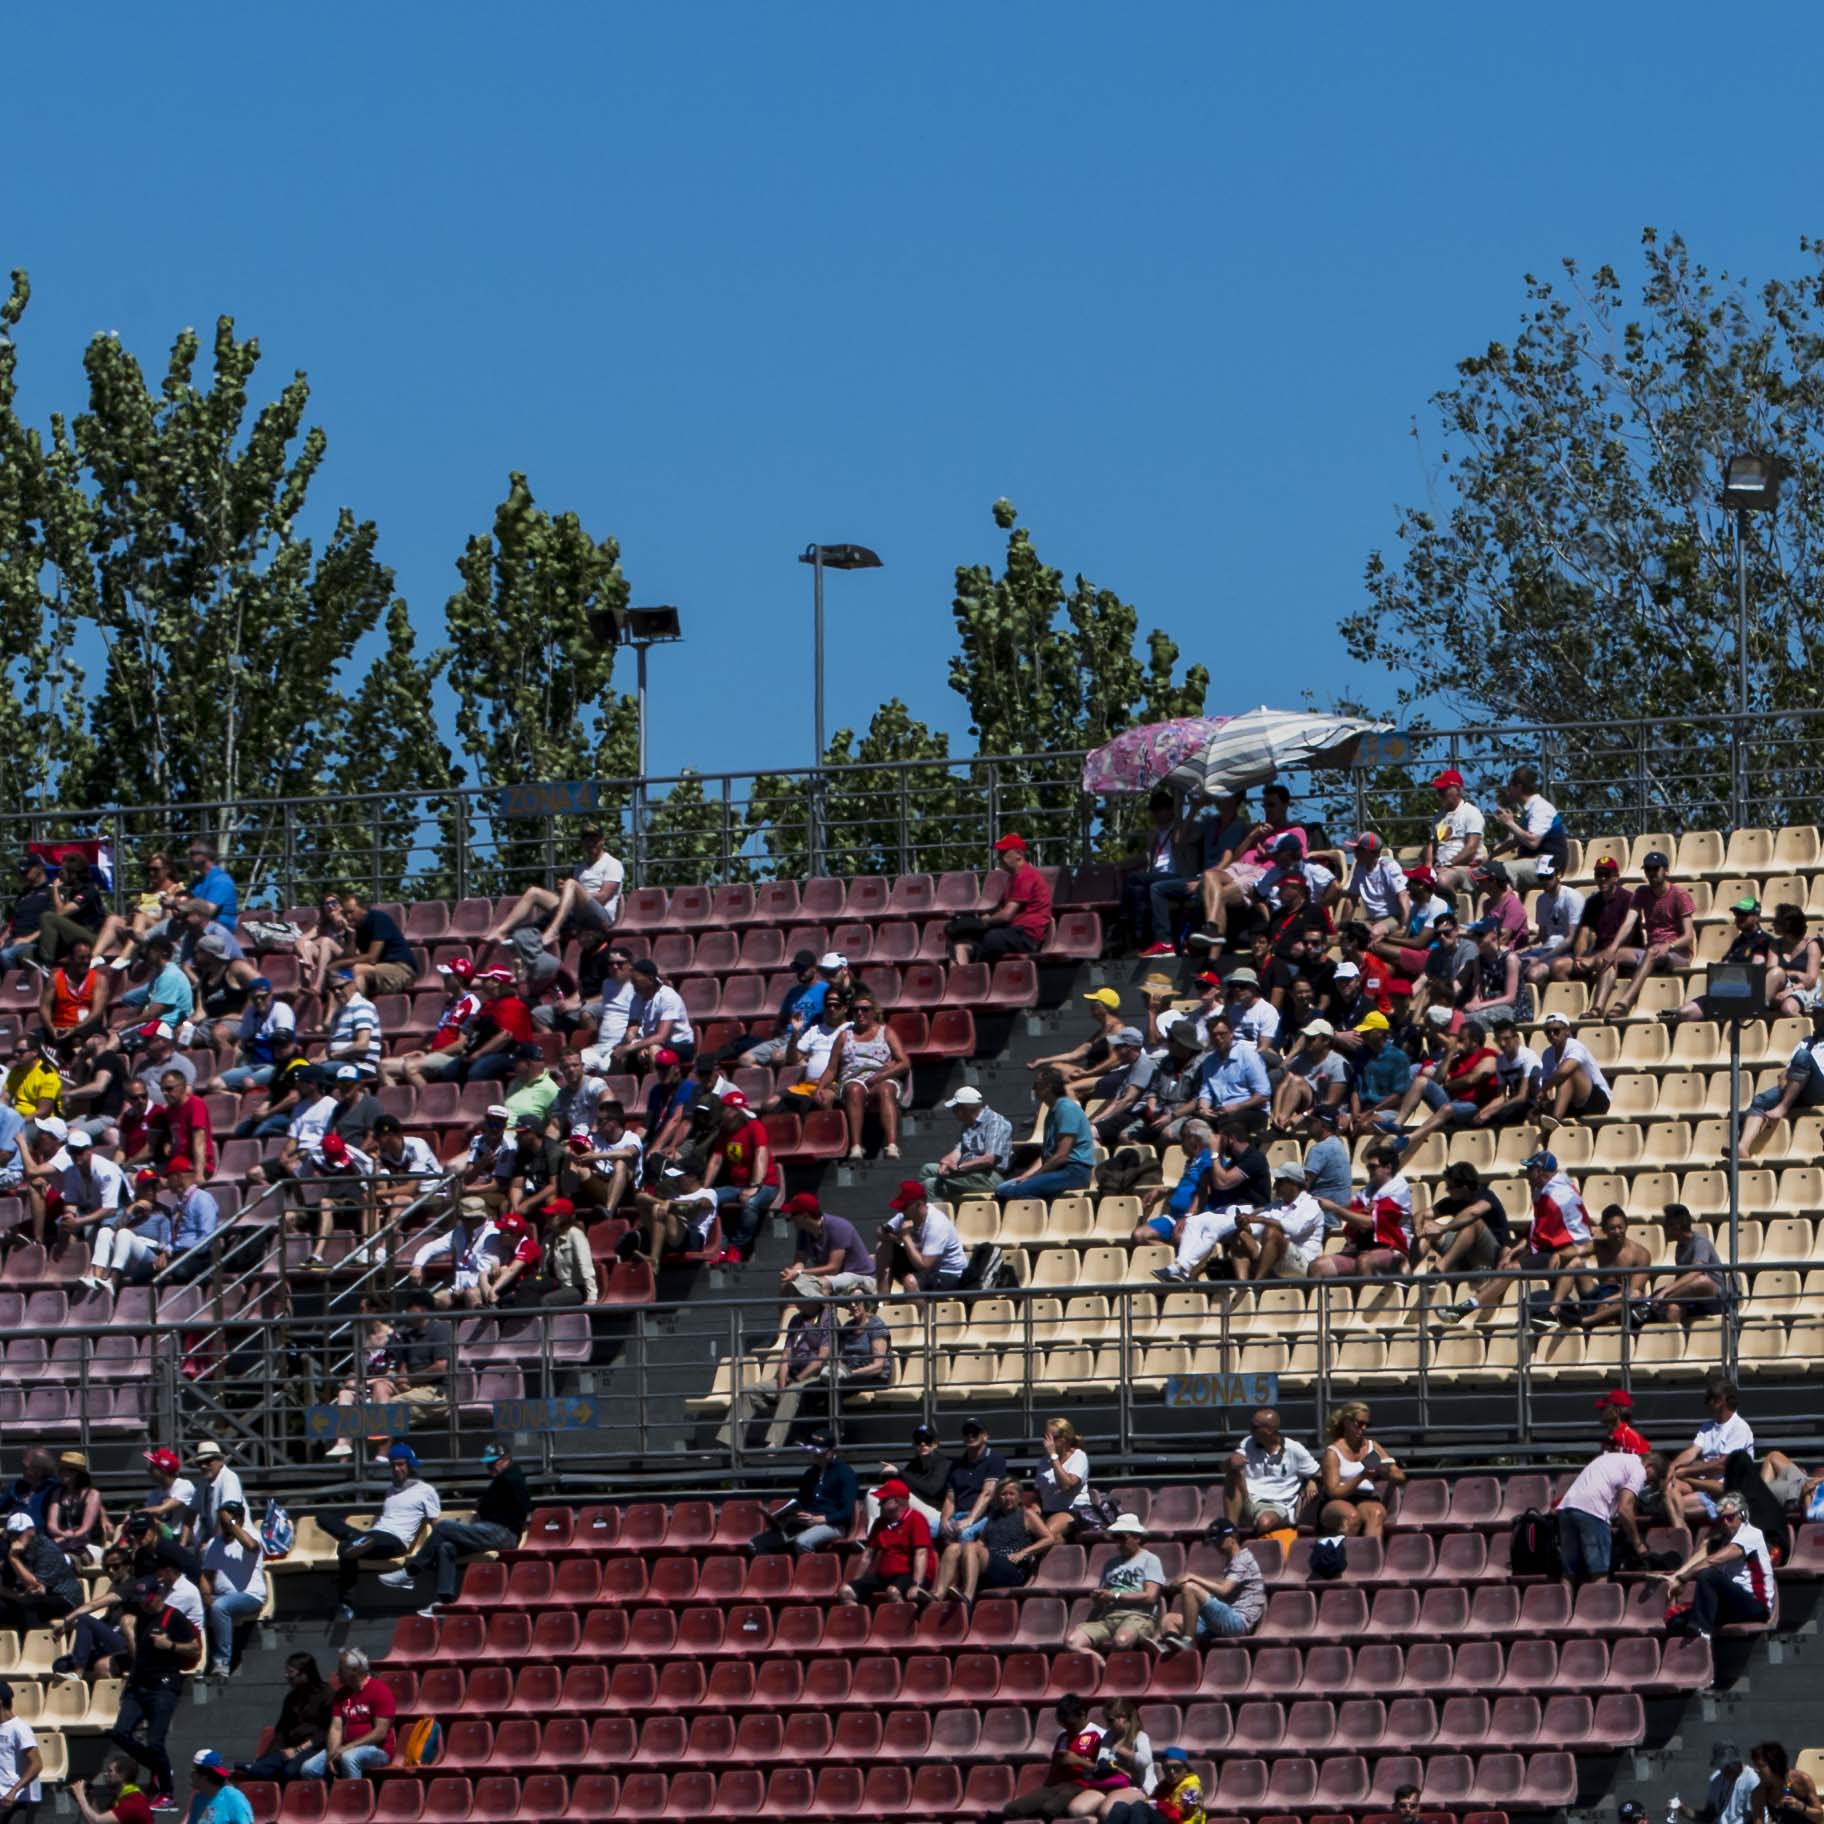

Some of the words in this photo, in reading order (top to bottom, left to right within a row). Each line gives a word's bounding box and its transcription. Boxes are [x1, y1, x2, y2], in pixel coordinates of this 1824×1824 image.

[508, 786, 572, 815] ZONA
[578, 784, 593, 811] 4
[1174, 1375, 1246, 1405] ZONA
[1255, 1375, 1269, 1404] 5
[393, 1404, 406, 1433] 4
